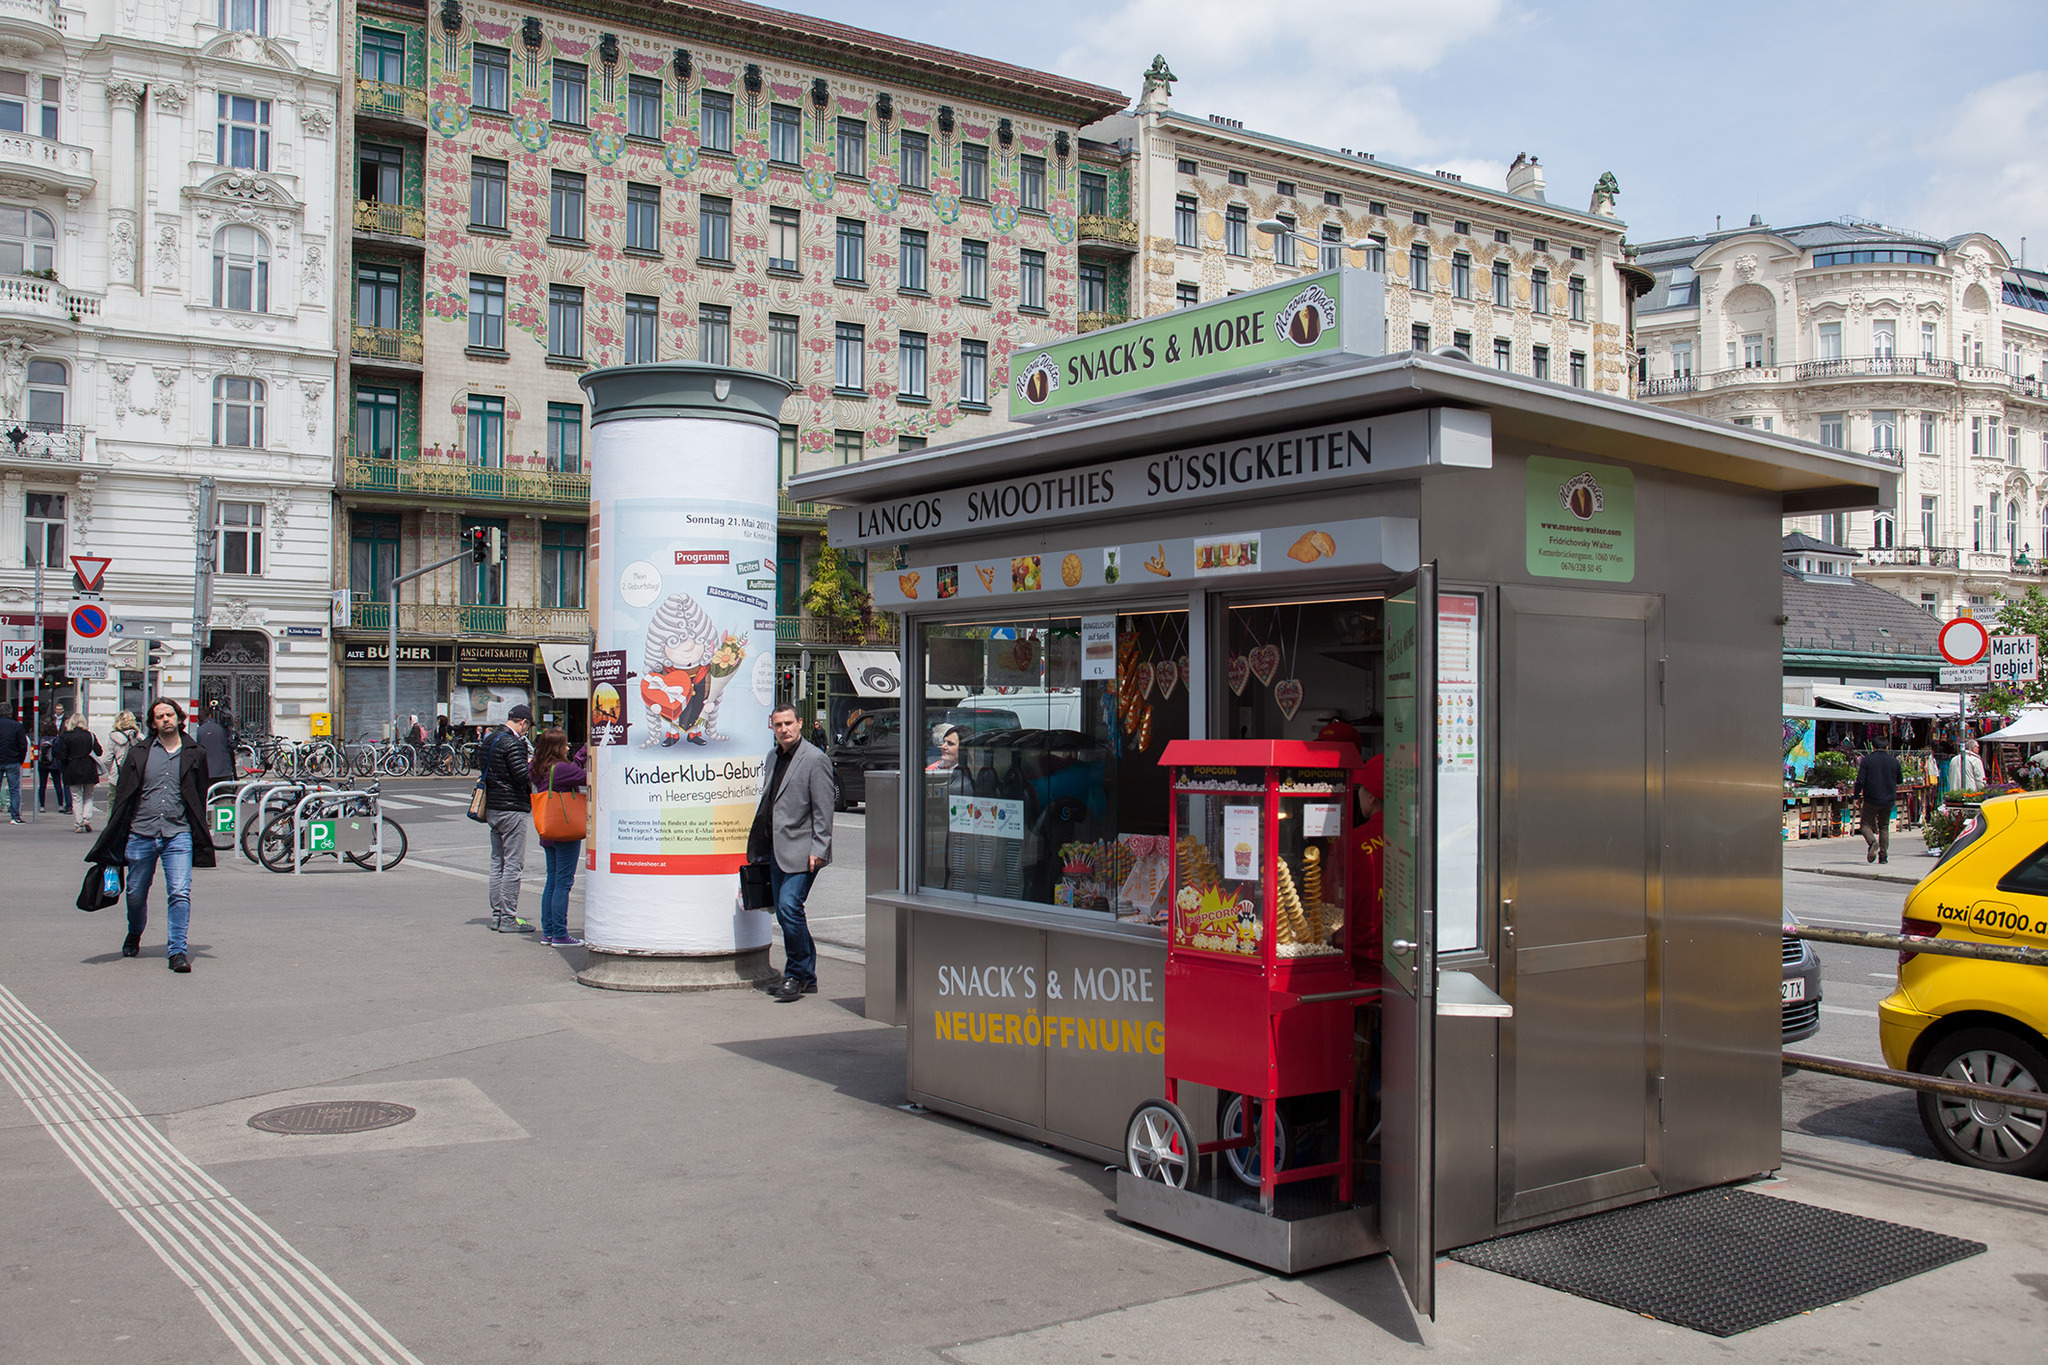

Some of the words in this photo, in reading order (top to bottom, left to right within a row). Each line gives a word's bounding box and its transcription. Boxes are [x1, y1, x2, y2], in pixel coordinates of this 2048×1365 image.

[1276, 289, 1309, 339] Maroni
[1309, 286, 1335, 327] Walter
[1165, 333, 1181, 364] &
[1191, 310, 1265, 359] MORE
[858, 498, 942, 538] LANGOS
[967, 469, 1115, 523] SMOOTHIES
[1147, 427, 1372, 496] SÜSSIGKEITEN
[1560, 475, 1585, 508] Maroni
[1585, 473, 1603, 509] Walter
[686, 514, 725, 527] Sonntag
[728, 517, 741, 526] 21.
[742, 518, 755, 528] Mai
[1541, 522, 1622, 536] www.maroni-walter.com
[1549, 536, 1590, 549] Fridrichovsky
[1591, 540, 1614, 550] Walter
[676, 552, 729, 564] Programm:
[1595, 552, 1608, 561] 1060
[1608, 553, 1624, 563] Wien
[738, 563, 759, 573] Reiten
[1088, 633, 1096, 641] auf
[68, 644, 108, 655] Kurzparkzone
[460, 648, 529, 658] ANSICHTSKARTEN
[1993, 639, 2035, 655] Markt-
[1994, 659, 2034, 680] gebiet
[1193, 767, 1237, 776] POPCORN
[1298, 769, 1345, 779] POPCORN
[648, 792, 662, 802] im
[217, 808, 234, 830] P
[311, 823, 329, 849] P
[1187, 906, 1239, 926] POPCORN
[1936, 903, 1970, 923] taxi
[1047, 970, 1063, 999] &
[1074, 967, 1154, 1002] MORE
[1789, 982, 1802, 998] TX
[935, 1008, 1166, 1055] NEUERÖFFNUNG
